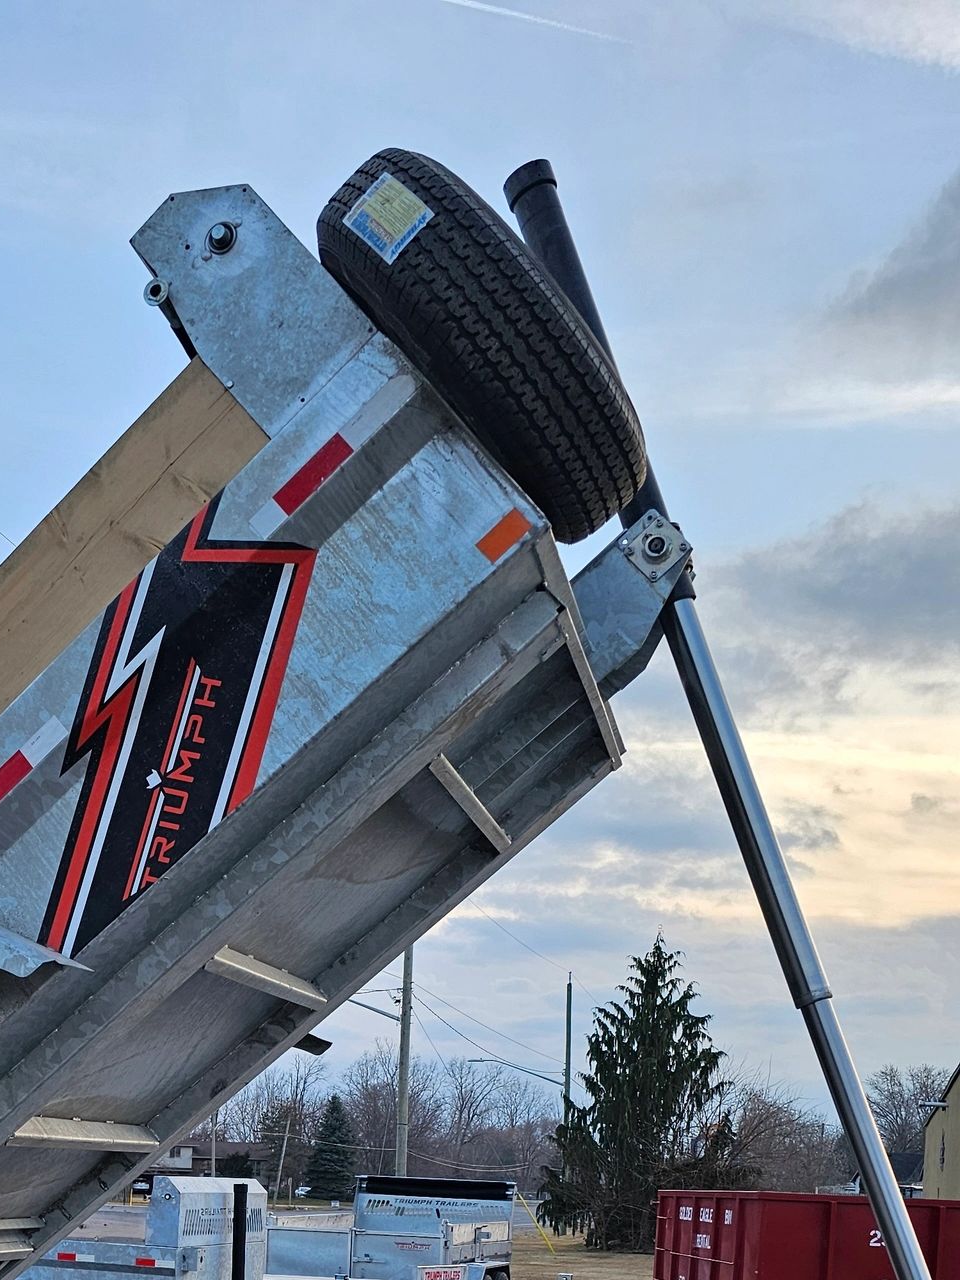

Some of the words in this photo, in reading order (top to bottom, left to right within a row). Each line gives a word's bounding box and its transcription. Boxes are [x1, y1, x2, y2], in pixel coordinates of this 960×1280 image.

[140, 675, 223, 890] TRIUMPH
[394, 1197, 433, 1206] TRIUMPH
[435, 1200, 480, 1208] TRAILERS
[699, 1207, 714, 1223] EAGLE
[869, 1229, 887, 1247] 2
